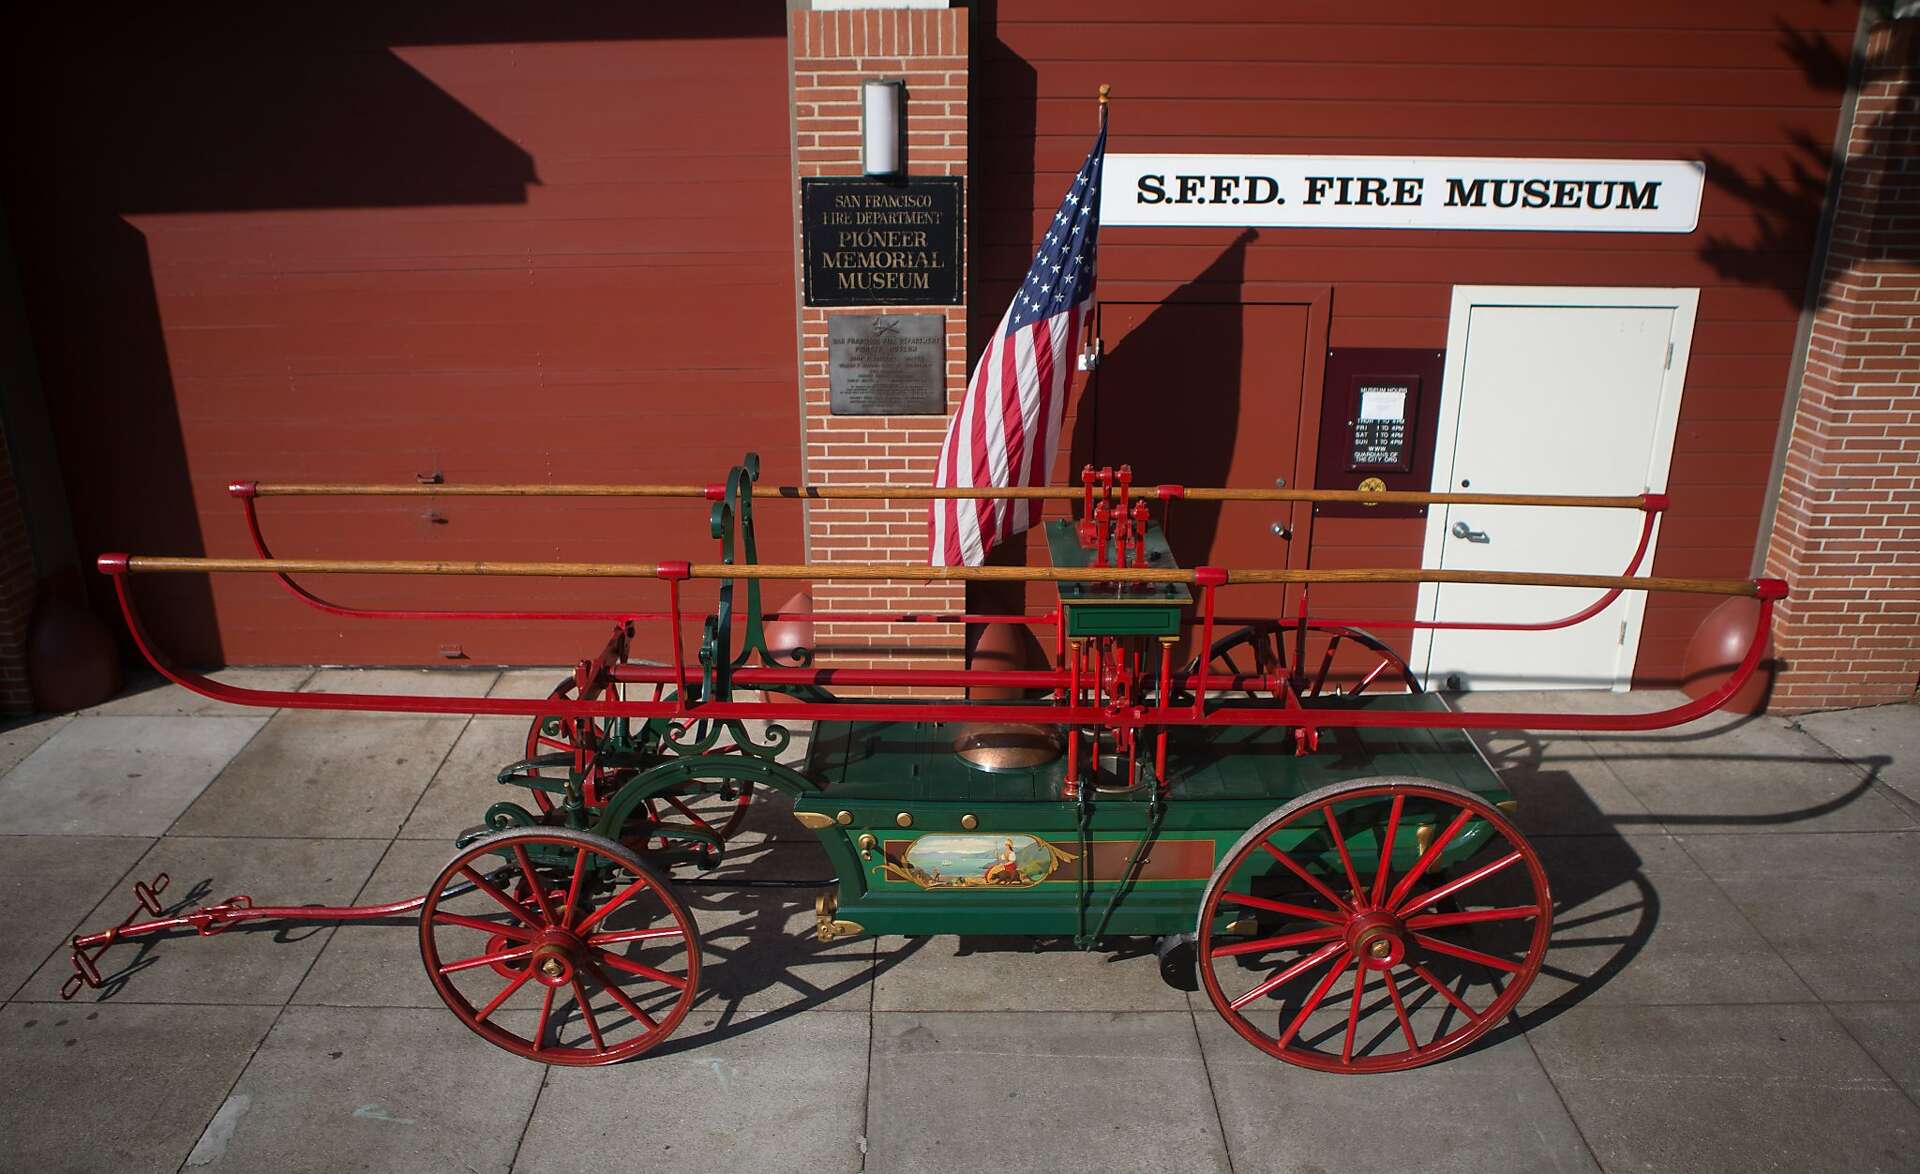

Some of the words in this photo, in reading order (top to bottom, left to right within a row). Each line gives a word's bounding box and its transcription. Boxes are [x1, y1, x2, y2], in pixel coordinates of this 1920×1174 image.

[1136, 174, 1286, 205] S.F.F.D.
[1302, 176, 1425, 206] FIRE
[1443, 178, 1662, 210] MUSEUM
[835, 195, 861, 208] SAN
[865, 195, 932, 208] FRANCISCO
[856, 211, 943, 225] DEPARTMENT
[839, 231, 929, 248] PIONEER
[823, 251, 945, 269] MEMORIAL
[838, 272, 930, 289] MUSEUM
